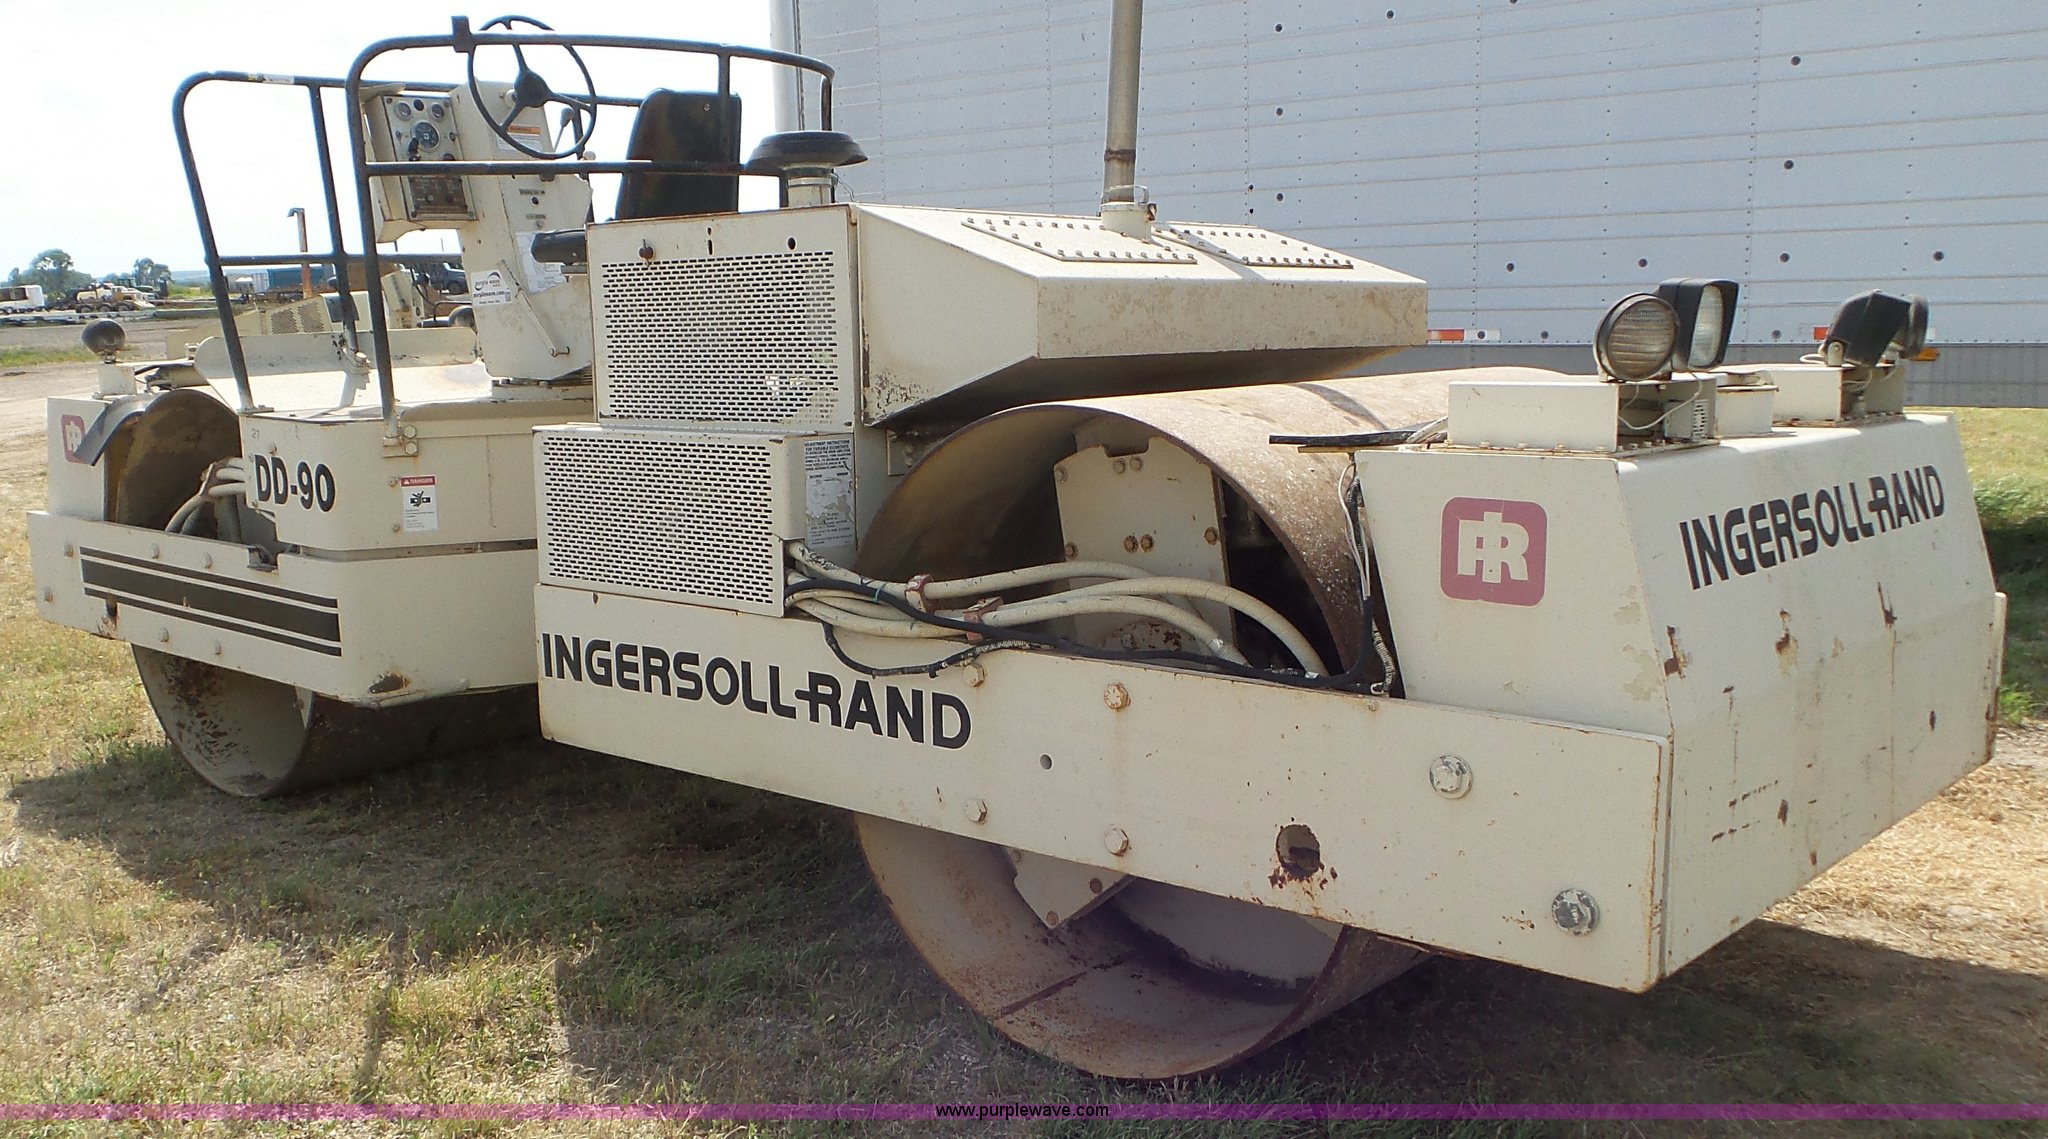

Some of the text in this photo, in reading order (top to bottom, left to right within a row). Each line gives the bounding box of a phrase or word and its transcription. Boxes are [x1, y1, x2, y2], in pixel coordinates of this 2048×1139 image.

[254, 454, 336, 512] DD-90
[1679, 464, 1946, 590] INGERSOLL-RAND
[542, 632, 972, 749] INGERSOLL-RAND
